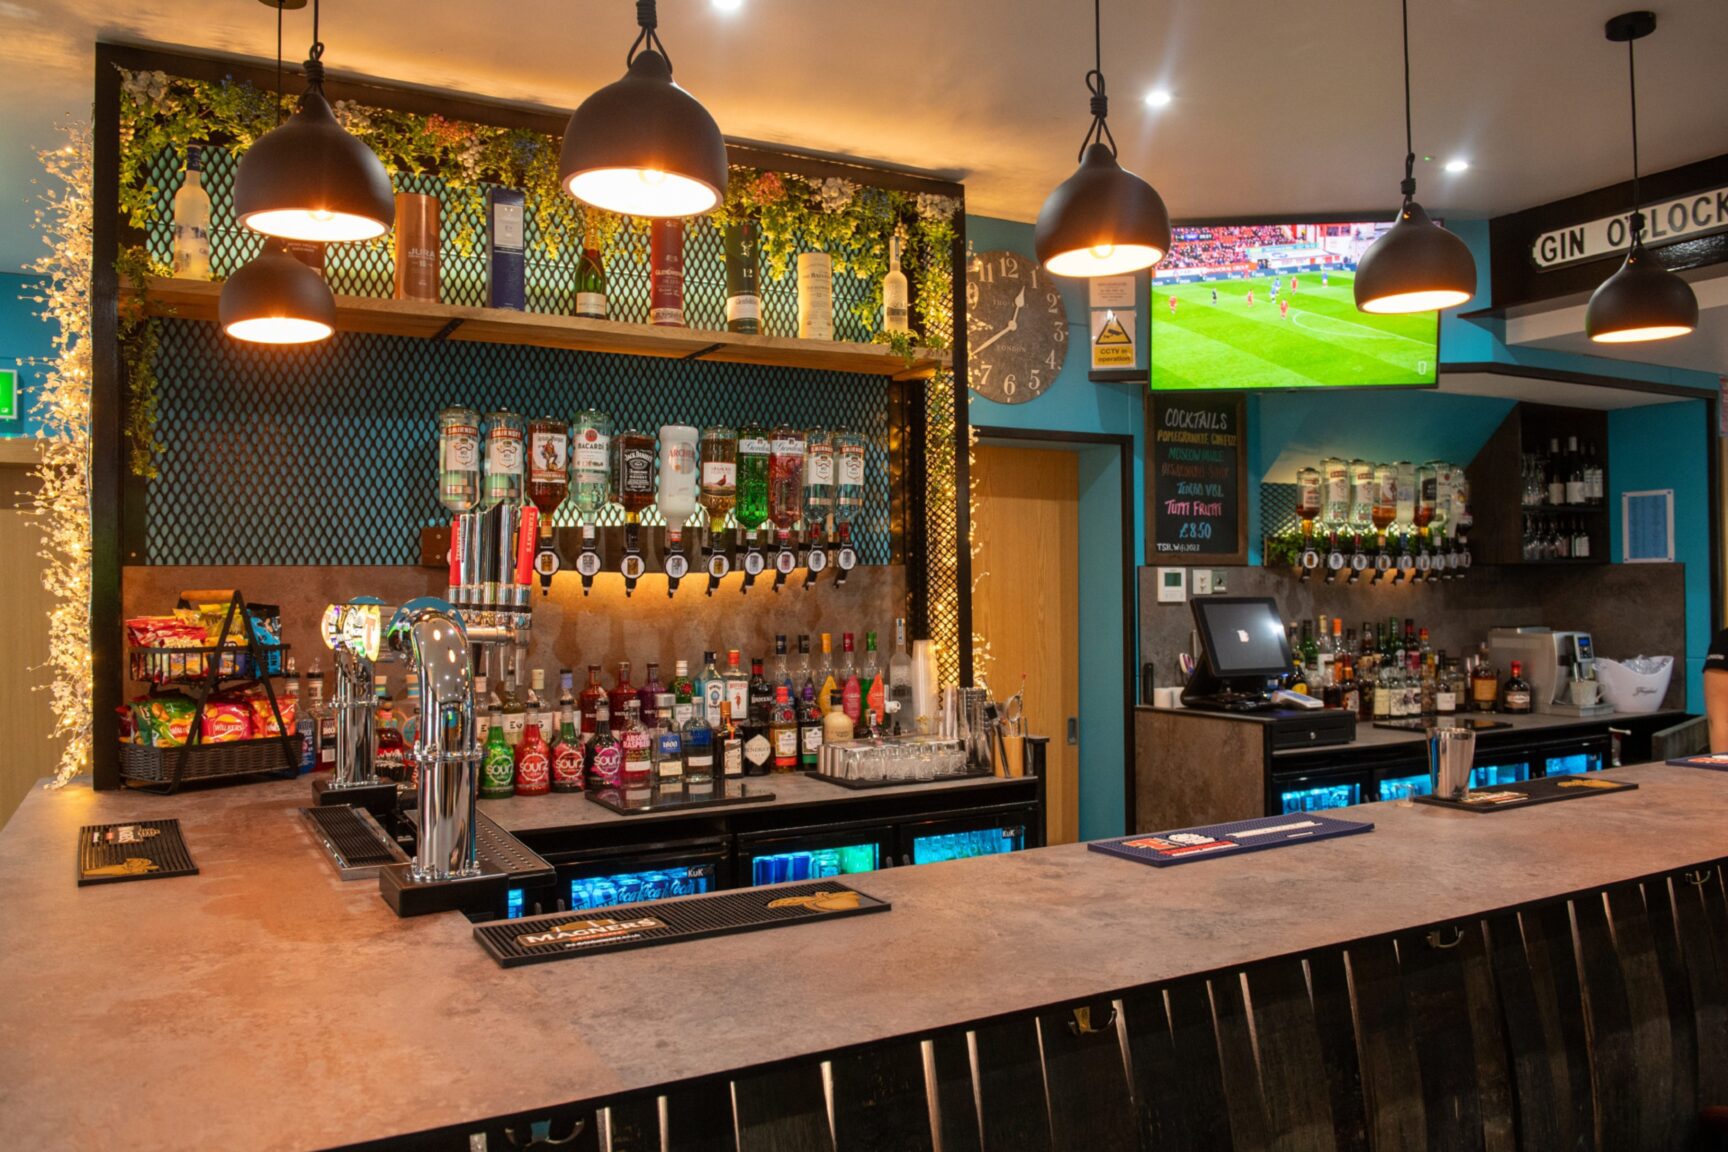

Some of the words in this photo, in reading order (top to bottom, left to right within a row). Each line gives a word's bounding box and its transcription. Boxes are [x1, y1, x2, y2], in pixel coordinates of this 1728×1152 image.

[408, 247, 435, 258] JURA
[1540, 227, 1585, 263] GIN
[743, 268, 753, 278] 12
[978, 262, 994, 283] 11
[1000, 257, 1019, 278] 12
[1030, 269, 1038, 289] 1
[1046, 293, 1058, 313] 2
[1053, 321, 1064, 342] 3
[1045, 349, 1056, 370] 4
[1098, 355, 1131, 363] operation
[980, 364, 992, 385] 7
[1003, 374, 1016, 395] 6
[1028, 369, 1041, 390] 5
[1165, 408, 1228, 430] COCKTAILS
[1164, 499, 1190, 515] TUTTI
[1193, 500, 1222, 516] FRUTTI
[525, 918, 657, 943] MAGNERS
